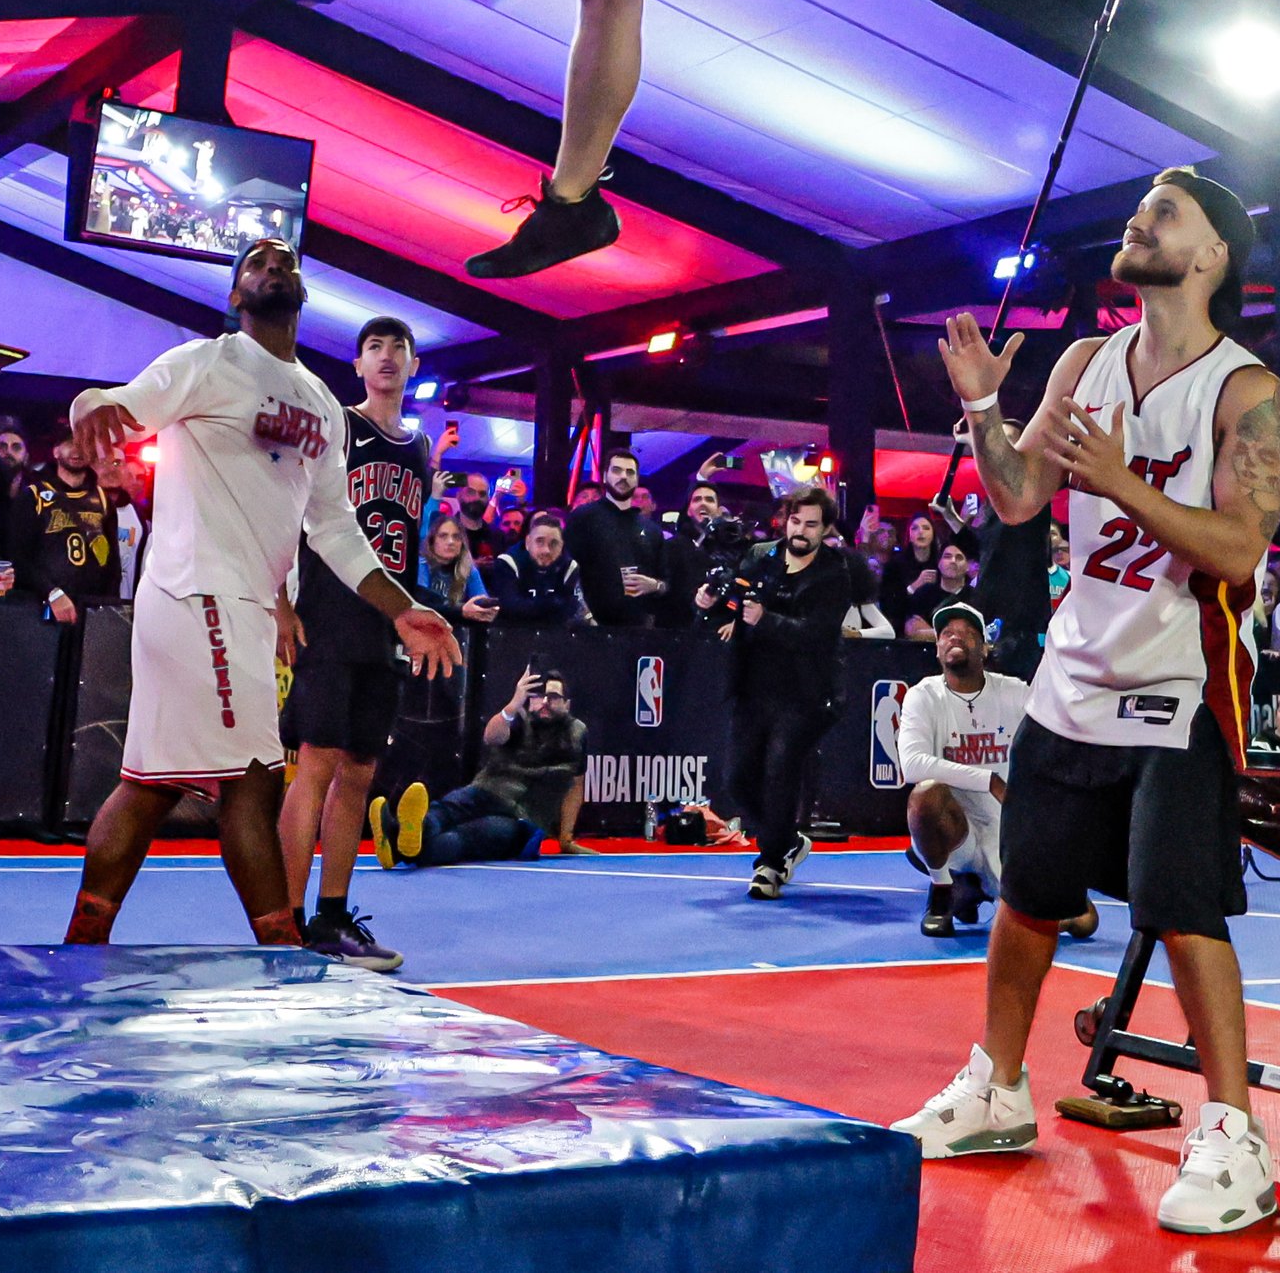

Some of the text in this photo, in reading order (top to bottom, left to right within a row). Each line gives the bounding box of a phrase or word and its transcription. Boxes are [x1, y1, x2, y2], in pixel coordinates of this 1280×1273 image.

[346, 461, 423, 520] CHICAG
[66, 532, 86, 566] 8
[366, 511, 408, 574] 23
[1082, 516, 1168, 593] 22
[202, 594, 236, 729] ROCKETS
[584, 755, 708, 804] NBA HOUSE
[875, 764, 894, 781] NBA
